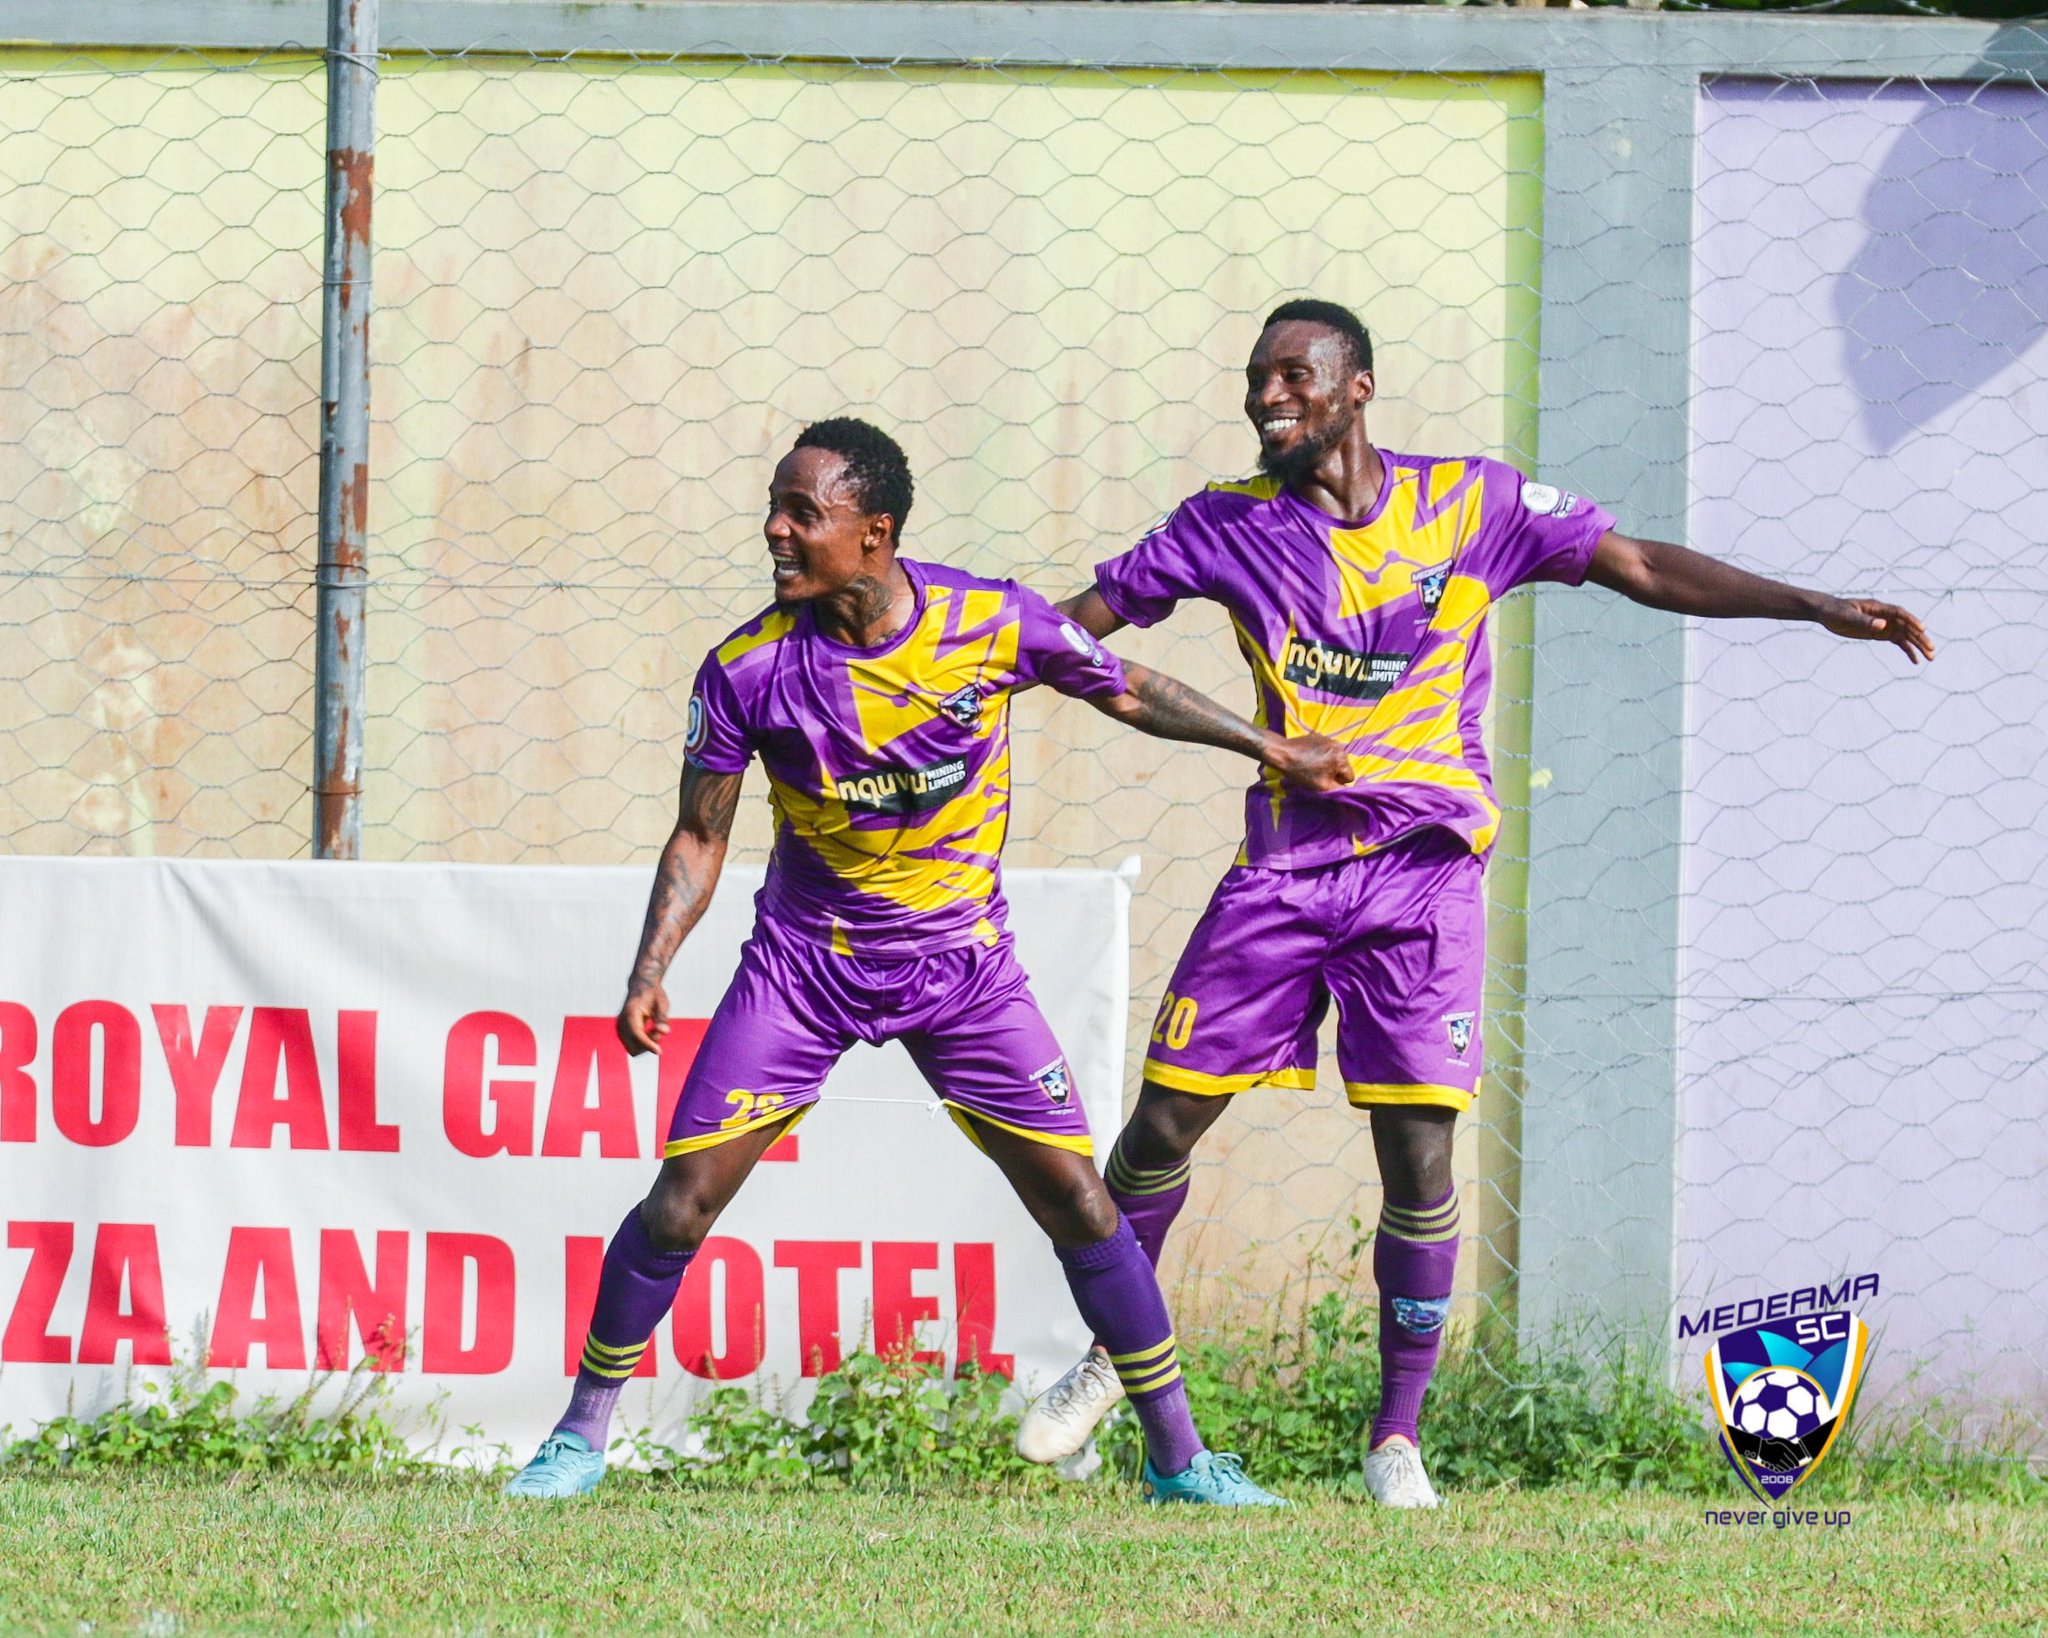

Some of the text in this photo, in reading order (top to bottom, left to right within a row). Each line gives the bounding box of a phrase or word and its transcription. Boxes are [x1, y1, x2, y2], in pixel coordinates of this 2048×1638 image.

[1367, 671, 1401, 683] IMITE
[926, 760, 965, 779] MINING
[928, 770, 966, 792] LIMITED
[1152, 991, 1199, 1051] 20
[442, 1010, 799, 1162] GAT
[208, 1226, 516, 1375] AND
